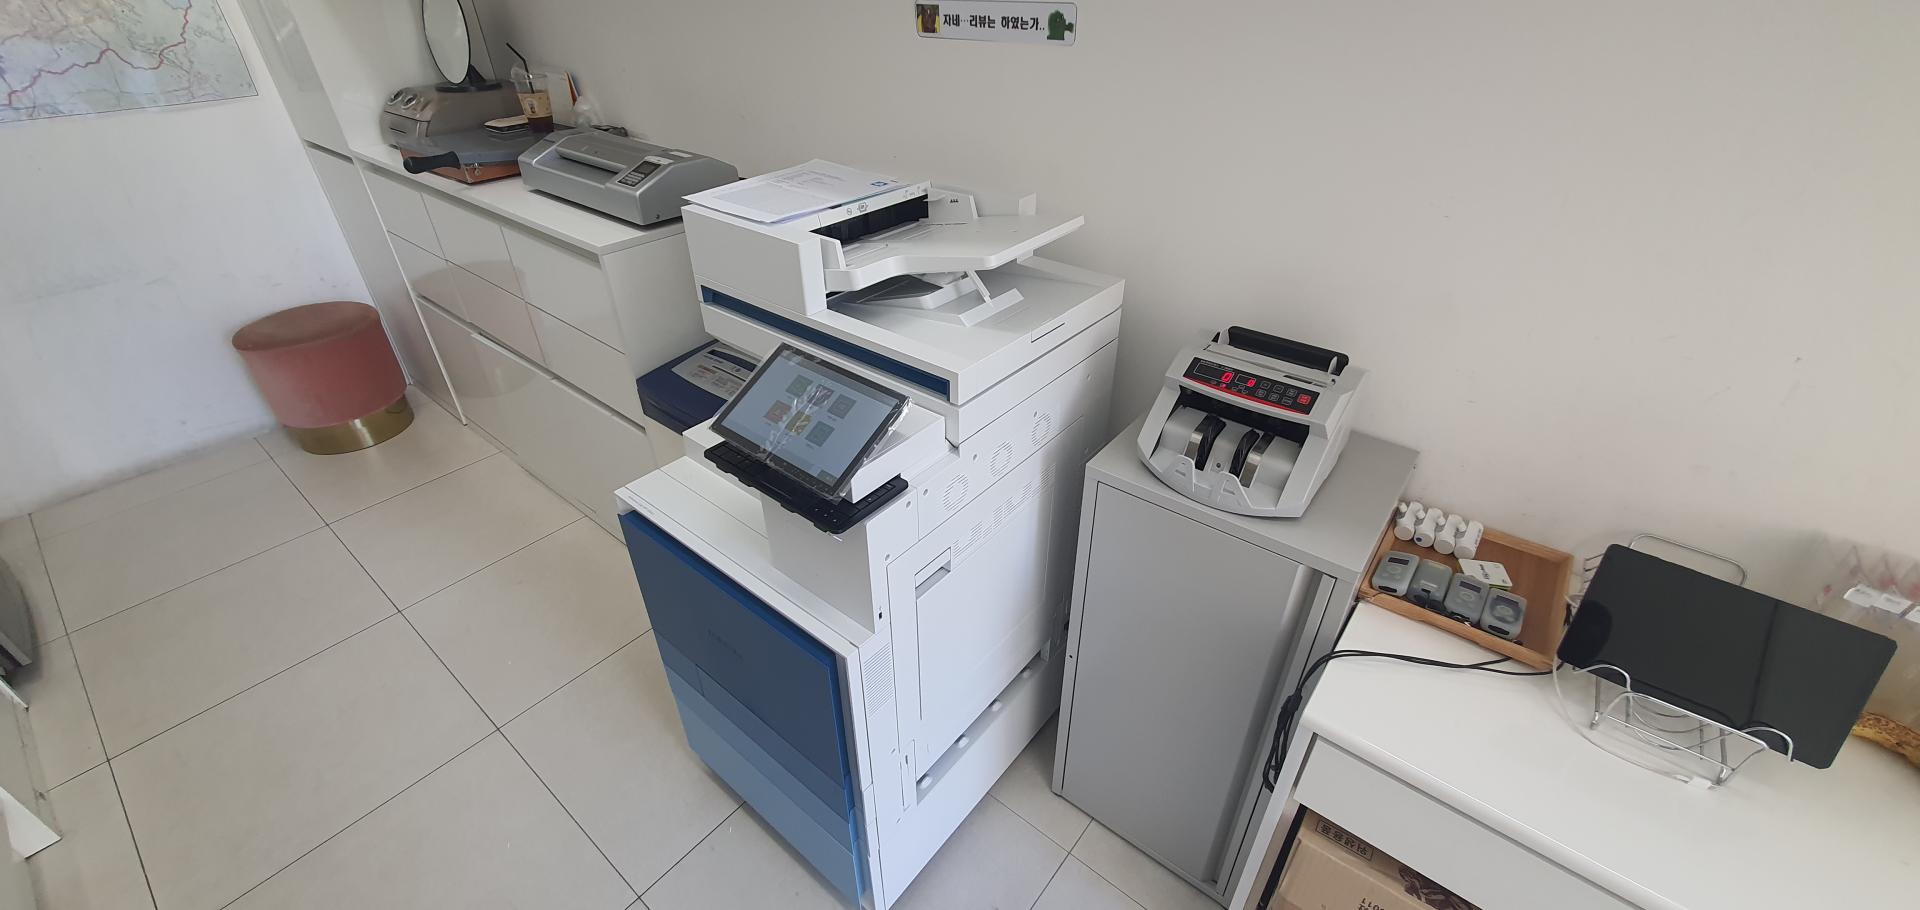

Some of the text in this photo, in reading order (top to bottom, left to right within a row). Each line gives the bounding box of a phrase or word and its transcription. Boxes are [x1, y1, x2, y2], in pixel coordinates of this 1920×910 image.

[1001, 16, 1045, 31] 하였는가..
[1221, 372, 1233, 383] 0
[1320, 823, 1368, 856] 위생용품
[1361, 898, 1385, 910] 011
